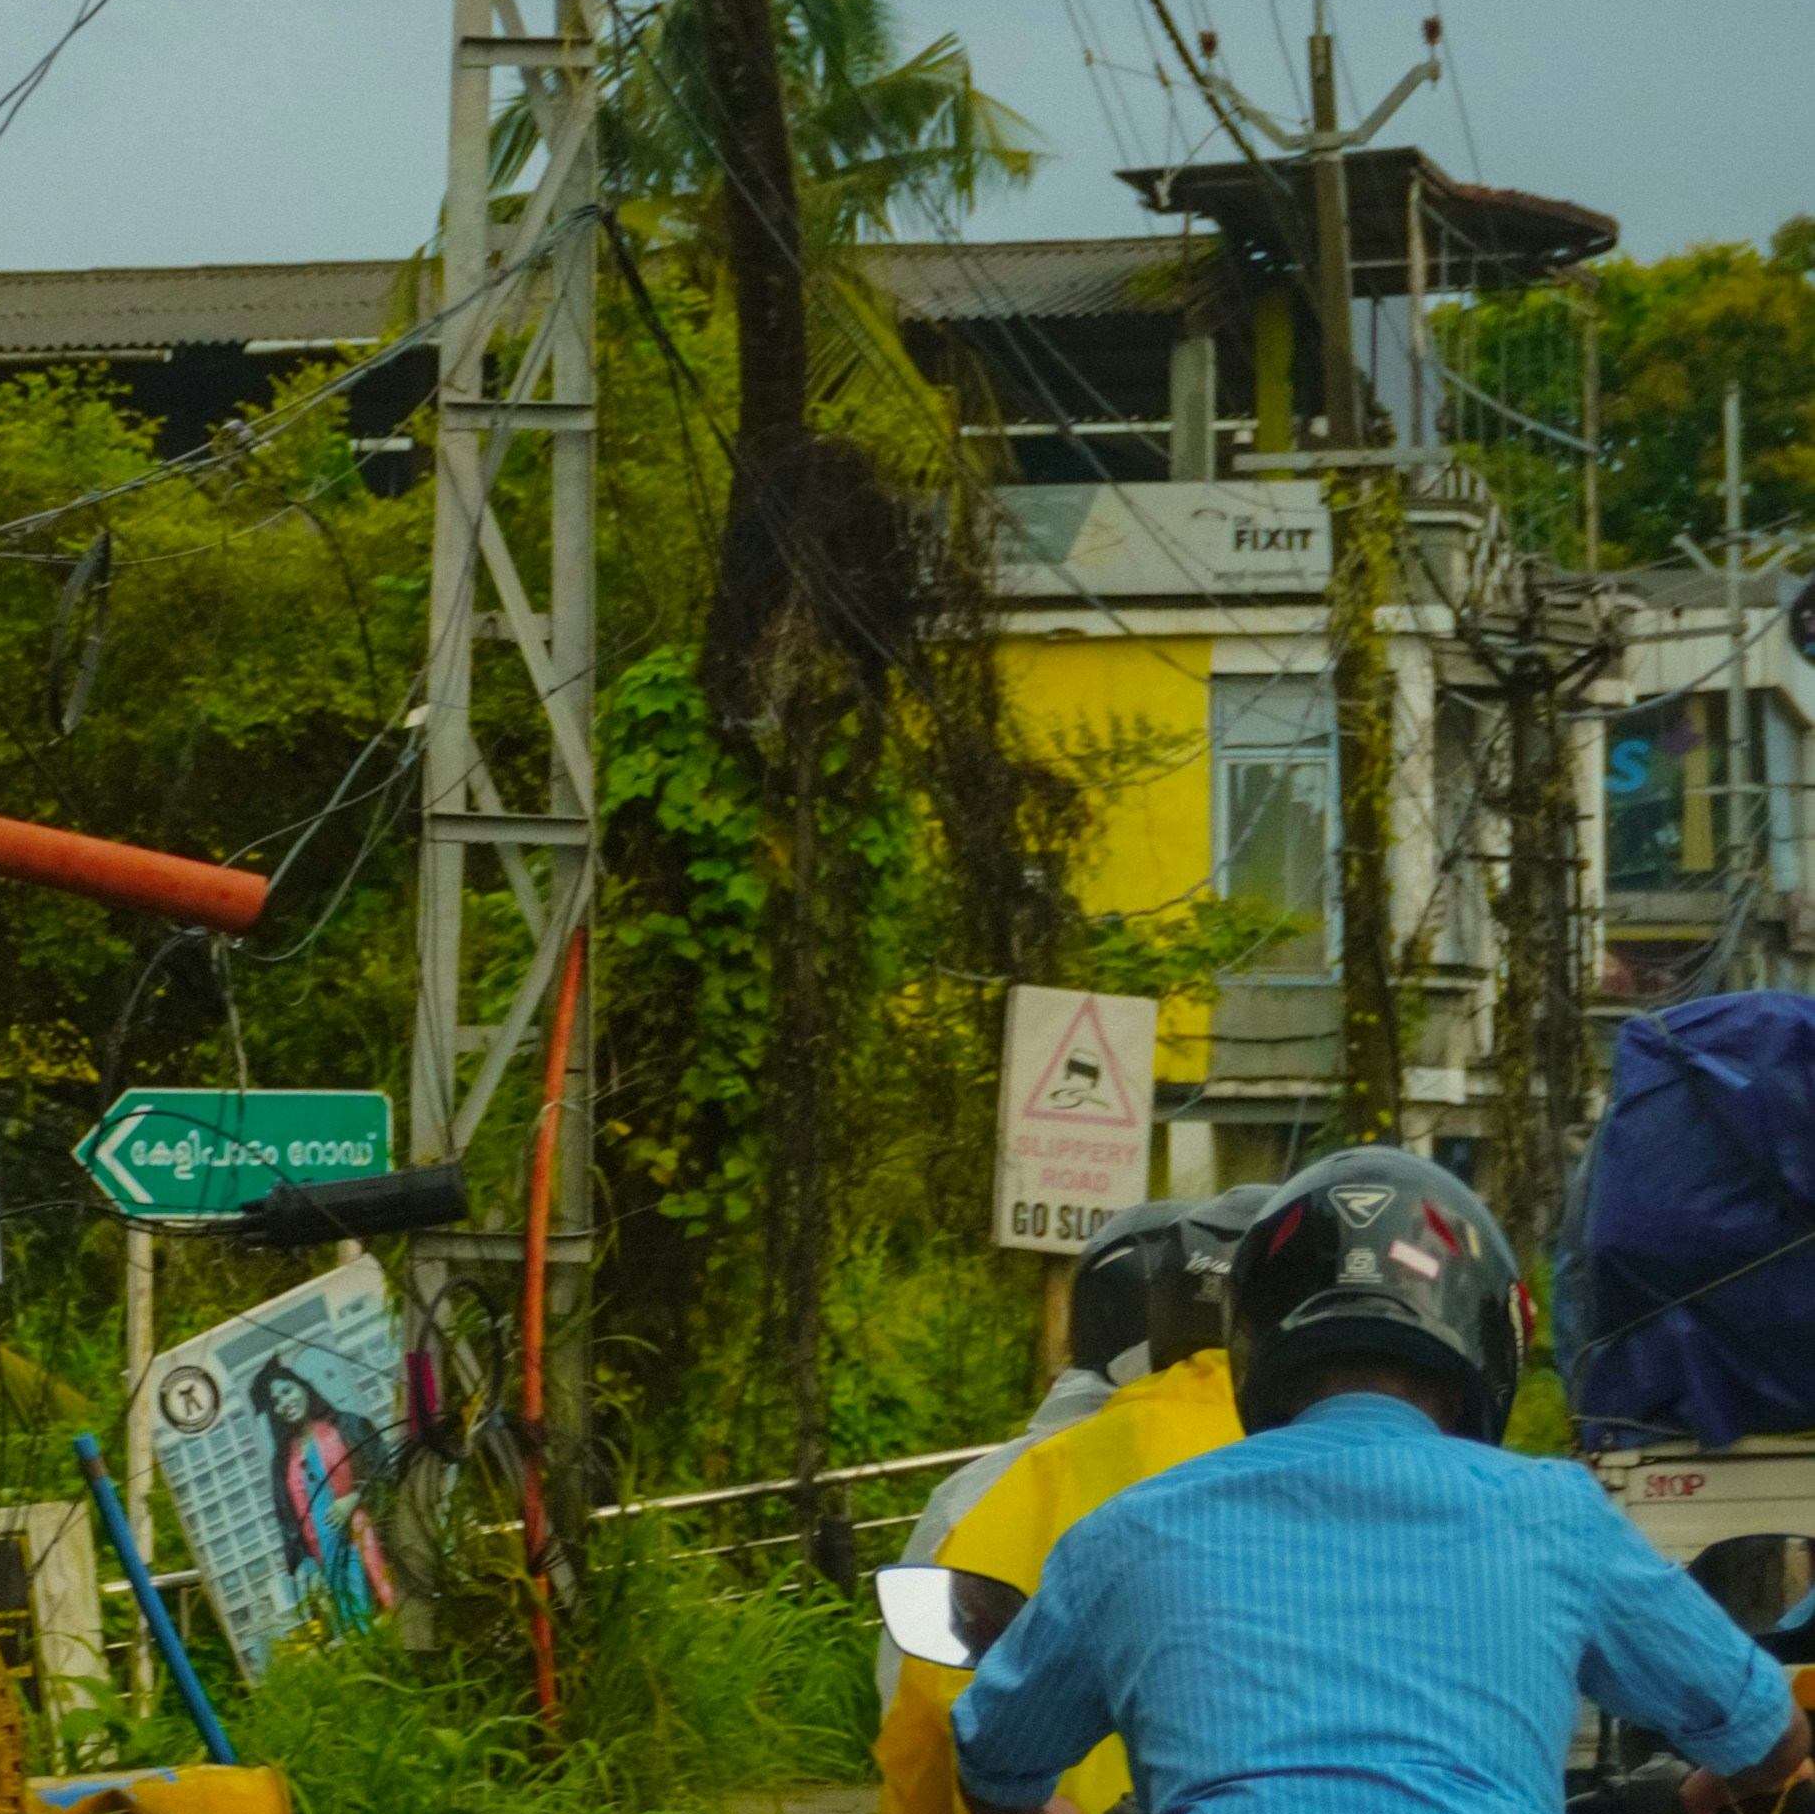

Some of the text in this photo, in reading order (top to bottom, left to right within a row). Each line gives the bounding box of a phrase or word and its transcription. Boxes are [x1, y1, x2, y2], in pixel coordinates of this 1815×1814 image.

[1233, 528, 1313, 552] FIXIT
[130, 1129, 378, 1180] കേളിപാടം റോഡ്
[1015, 1135, 1139, 1165] SLIPPERY
[1039, 1168, 1112, 1194] ROAD
[1012, 1200, 1115, 1241] GO SLO
[1644, 1472, 1706, 1498] STOP
